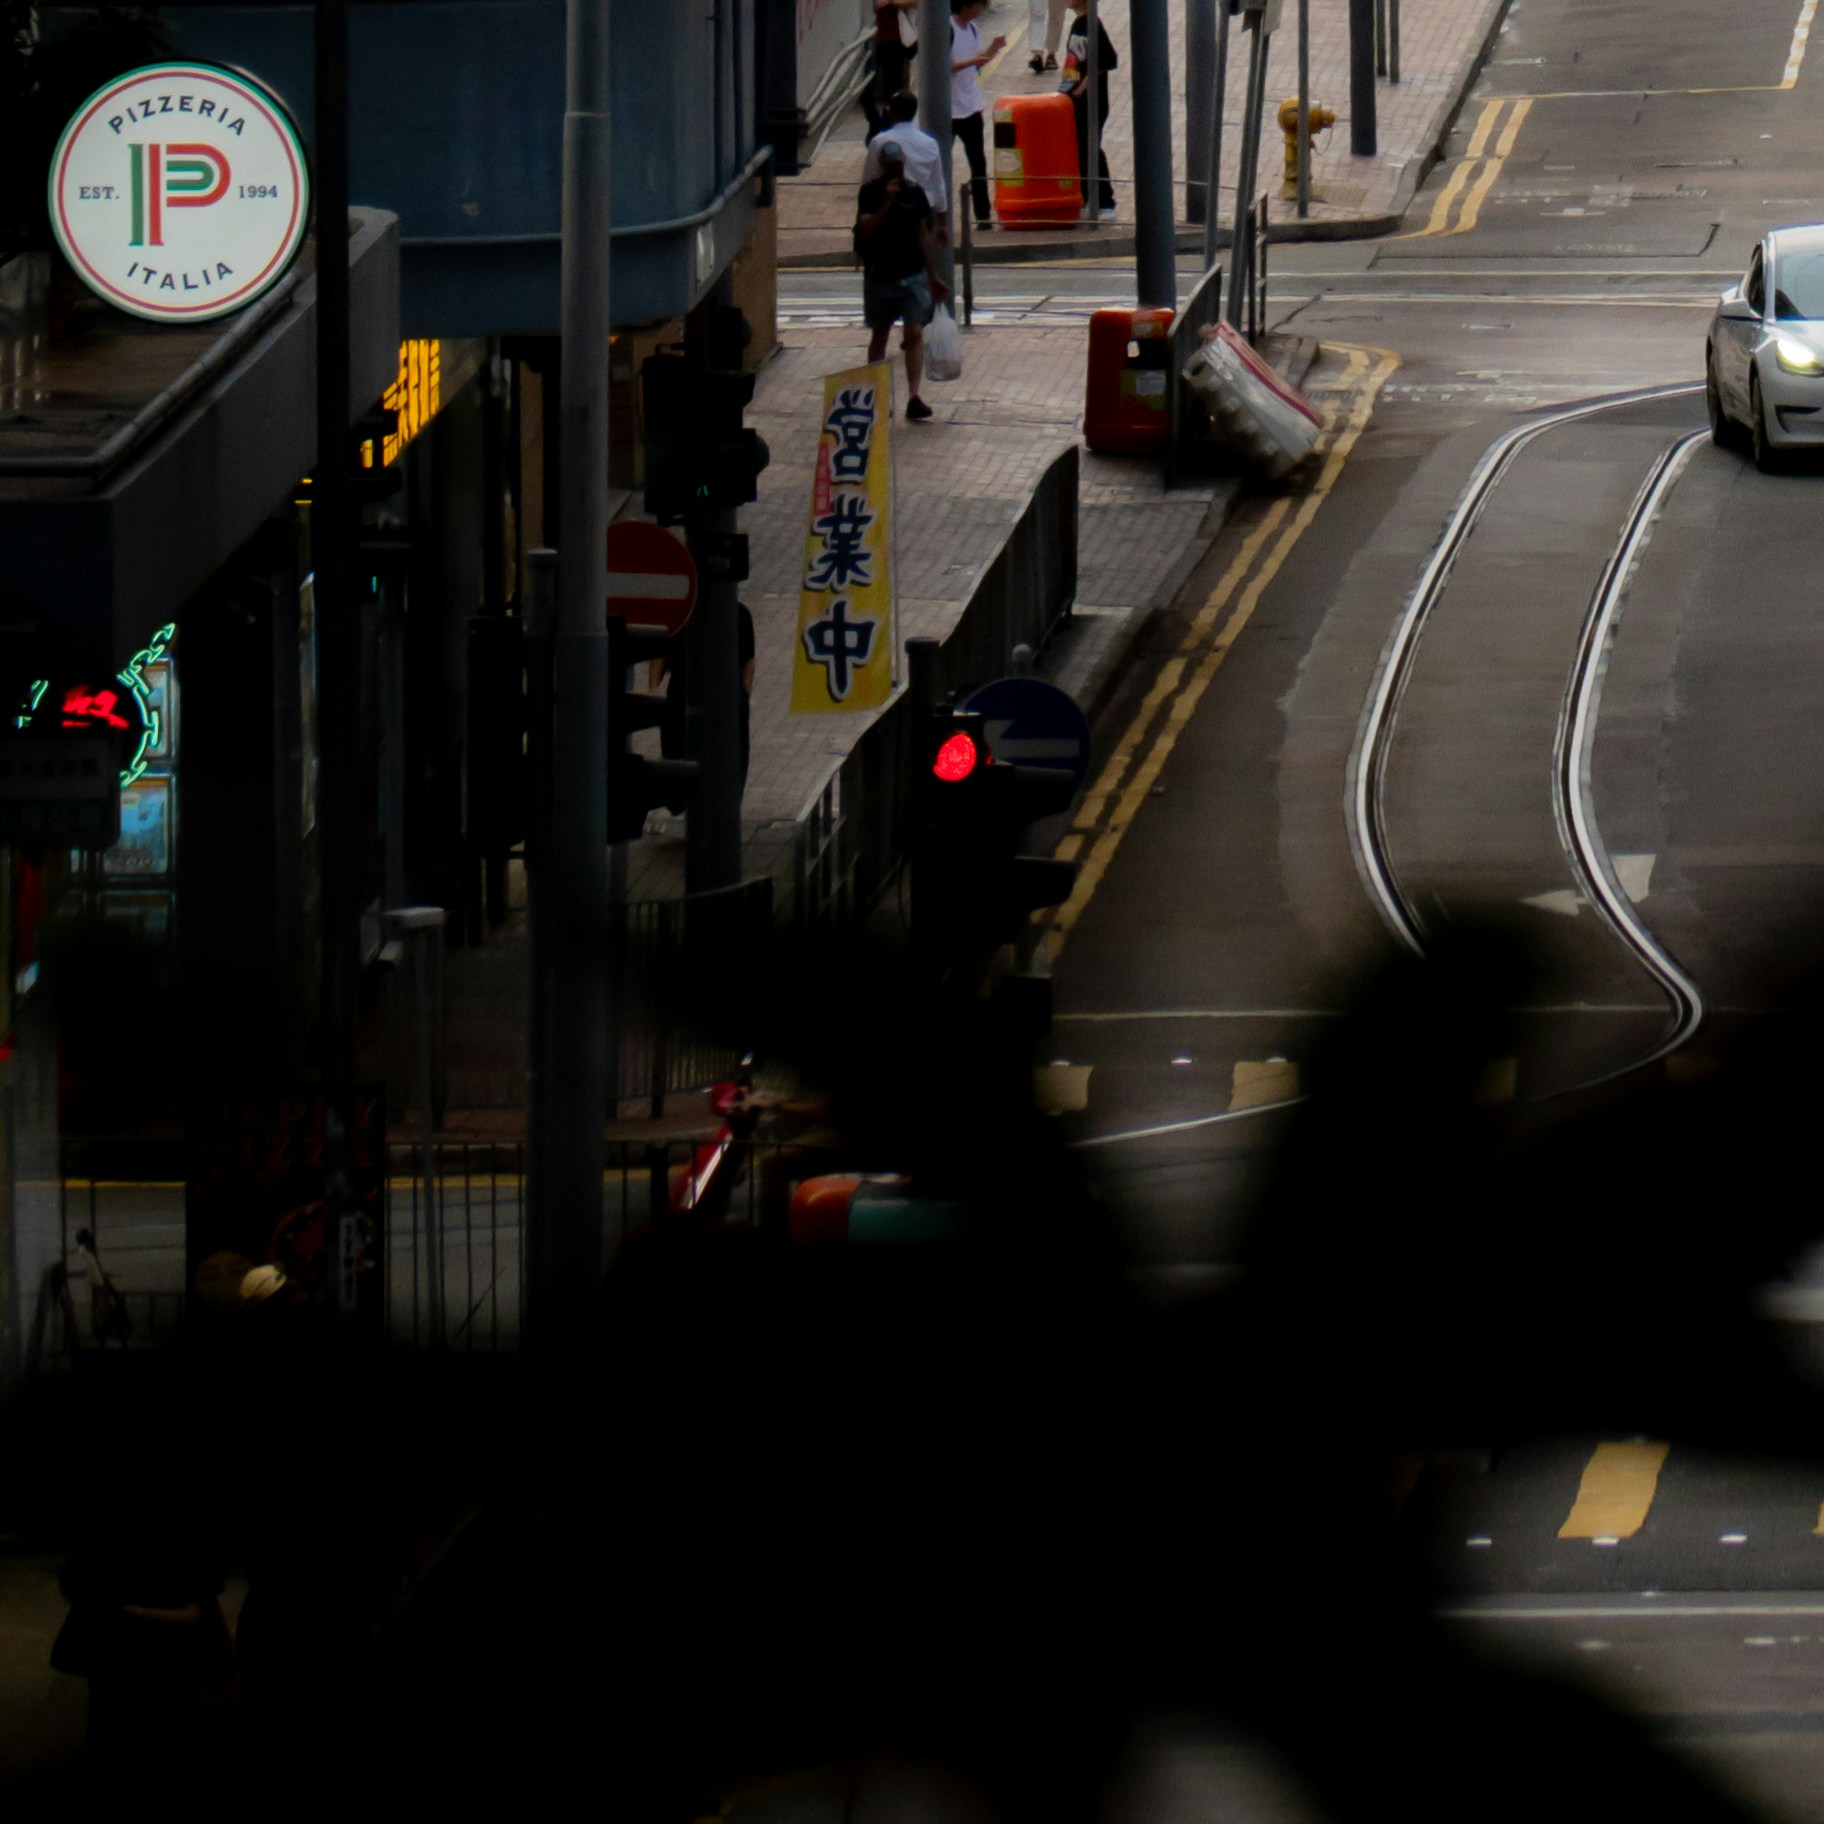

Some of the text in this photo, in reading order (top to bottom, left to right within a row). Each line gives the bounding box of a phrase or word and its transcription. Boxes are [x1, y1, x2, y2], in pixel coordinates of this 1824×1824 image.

[108, 95, 247, 136] PIZZERIA
[79, 185, 120, 200] EST.
[238, 185, 279, 199] 1994
[127, 260, 235, 291] ITALIA
